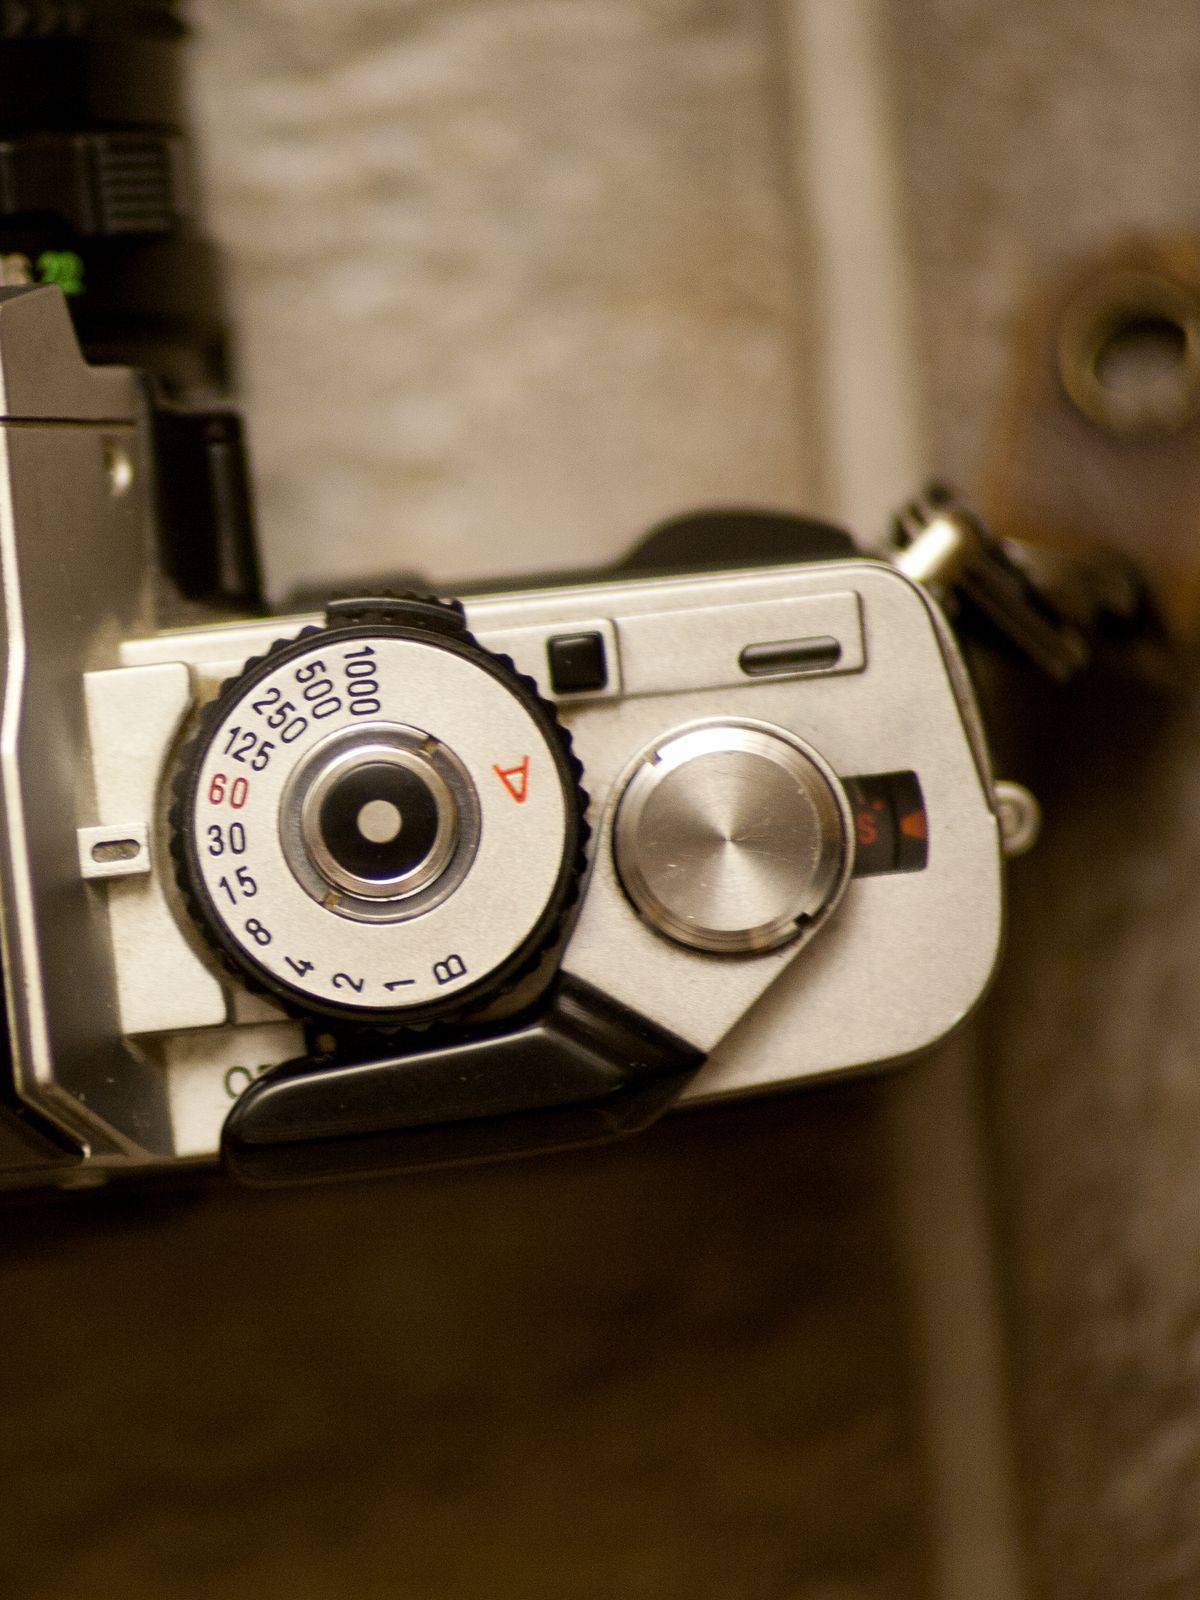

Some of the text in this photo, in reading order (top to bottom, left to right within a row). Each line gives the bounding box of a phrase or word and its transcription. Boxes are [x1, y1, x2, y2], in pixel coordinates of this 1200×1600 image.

[295, 660, 342, 720] 500
[343, 646, 381, 716] 1000
[252, 687, 308, 744] 250
[221, 726, 276, 772] 125
[208, 773, 249, 810] 60
[492, 755, 530, 804] A
[207, 822, 247, 857] 30
[219, 866, 258, 905] 15
[244, 918, 273, 946] 8
[284, 955, 316, 978] 4
[331, 971, 365, 993] 2
[383, 978, 416, 992] 1
[433, 953, 467, 985] B
